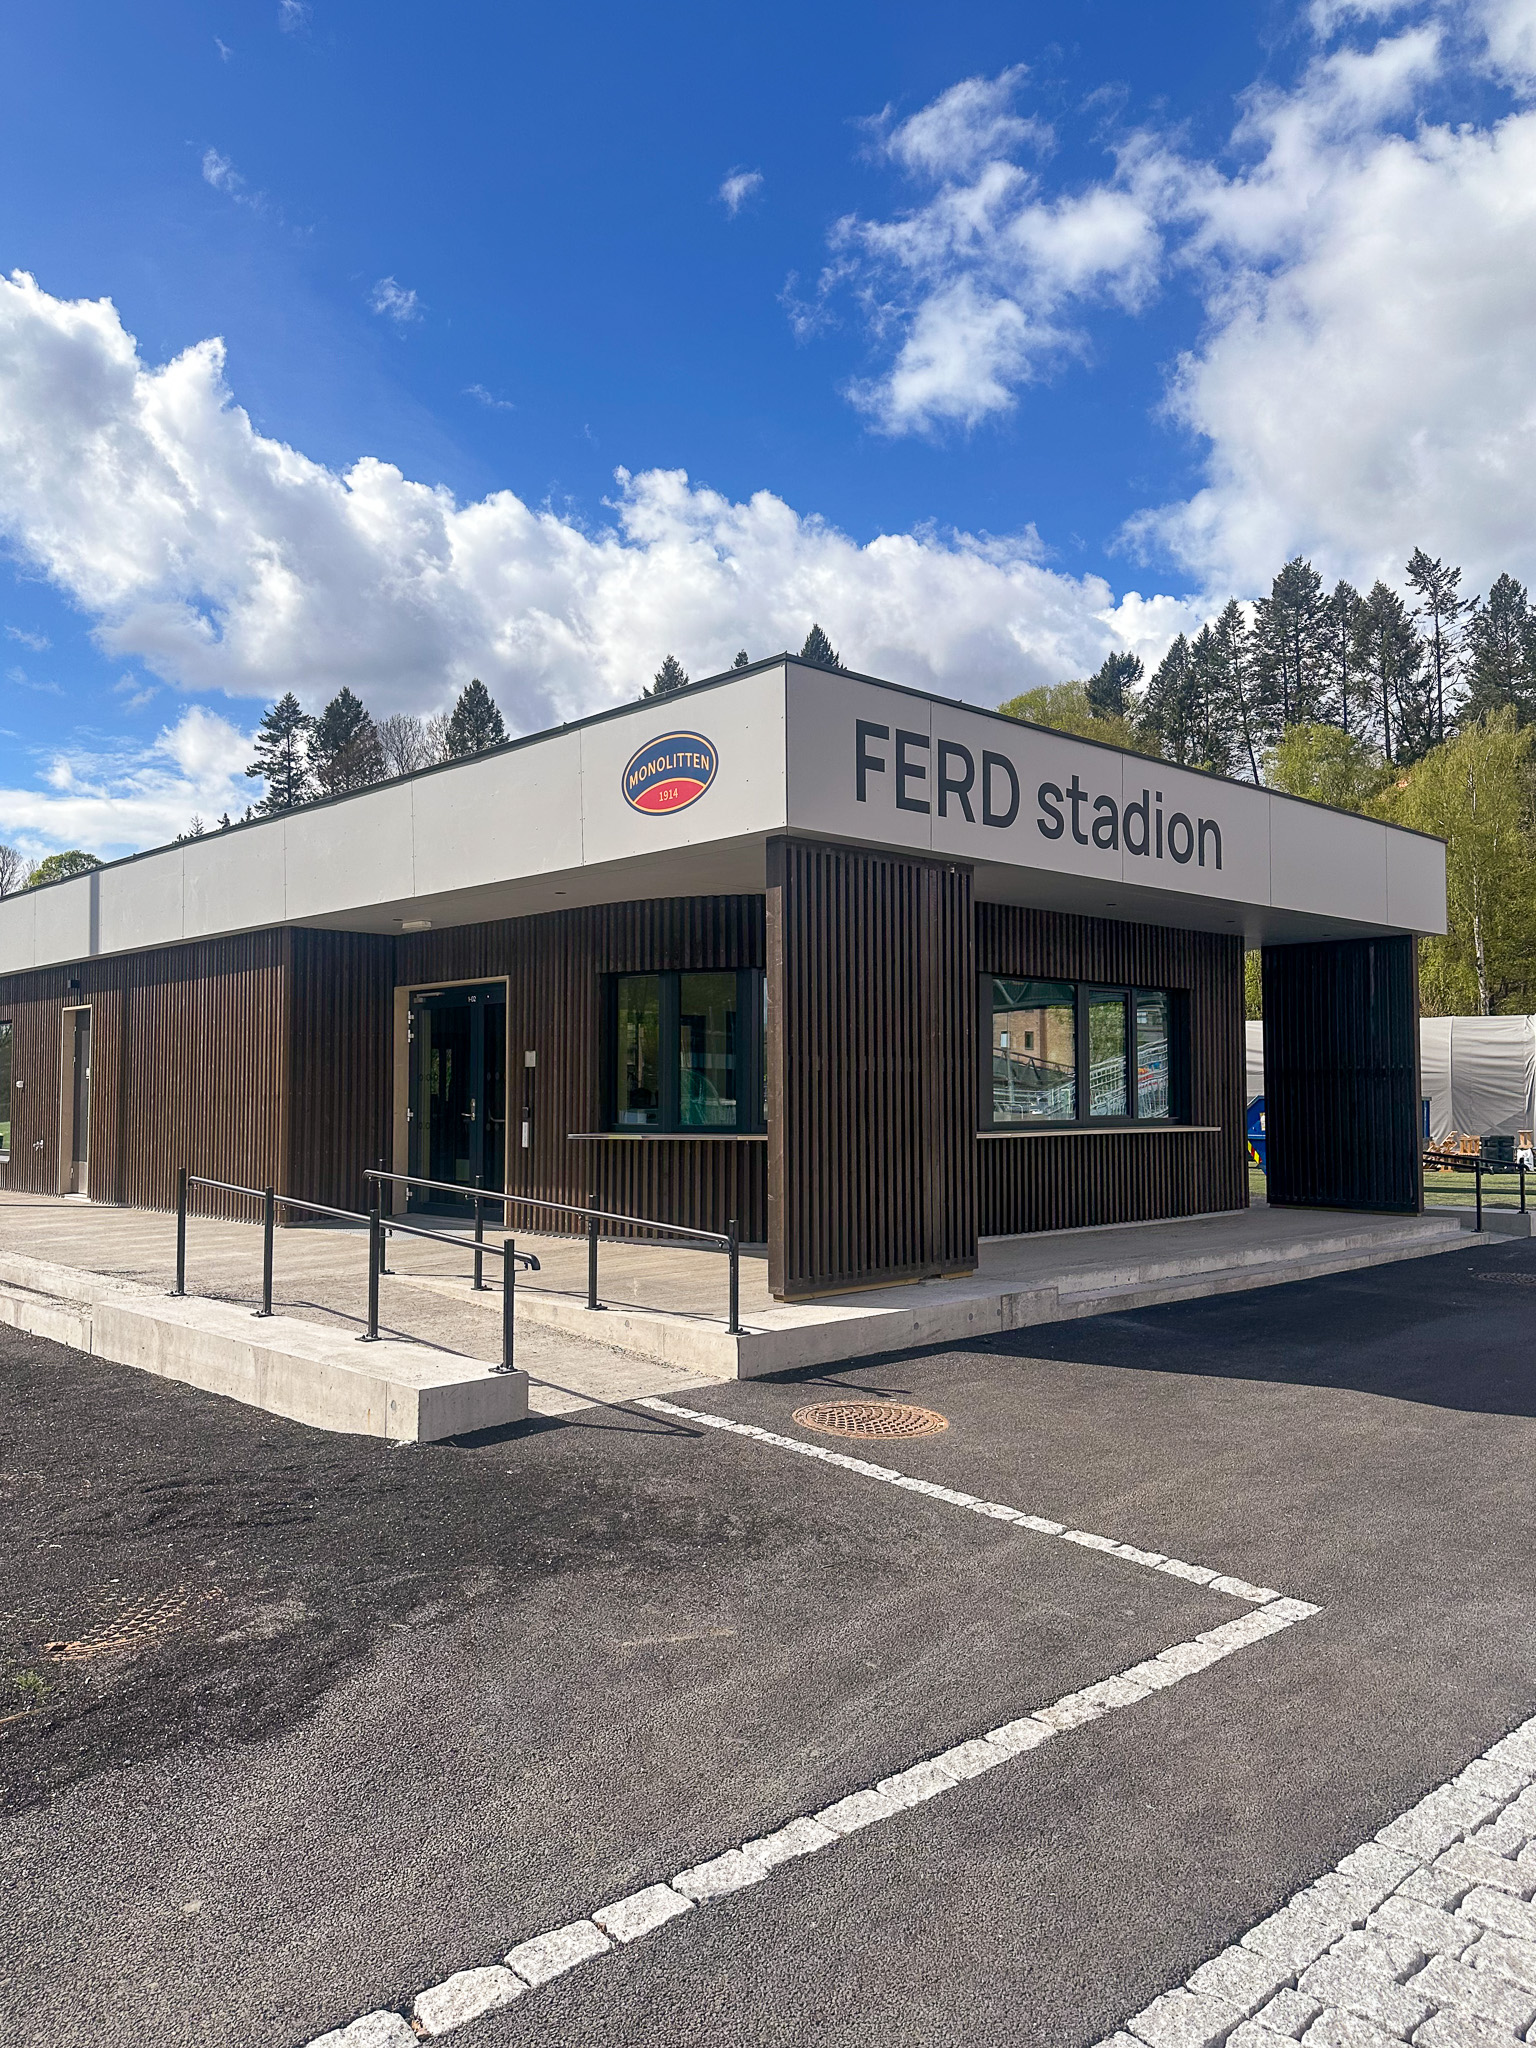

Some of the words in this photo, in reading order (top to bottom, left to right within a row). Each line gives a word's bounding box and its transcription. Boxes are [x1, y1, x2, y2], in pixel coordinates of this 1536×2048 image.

[629, 752, 710, 790] MONOLITTEN
[658, 787, 679, 802] 1914
[855, 718, 1020, 829] FERD
[1037, 774, 1222, 870] stadion
